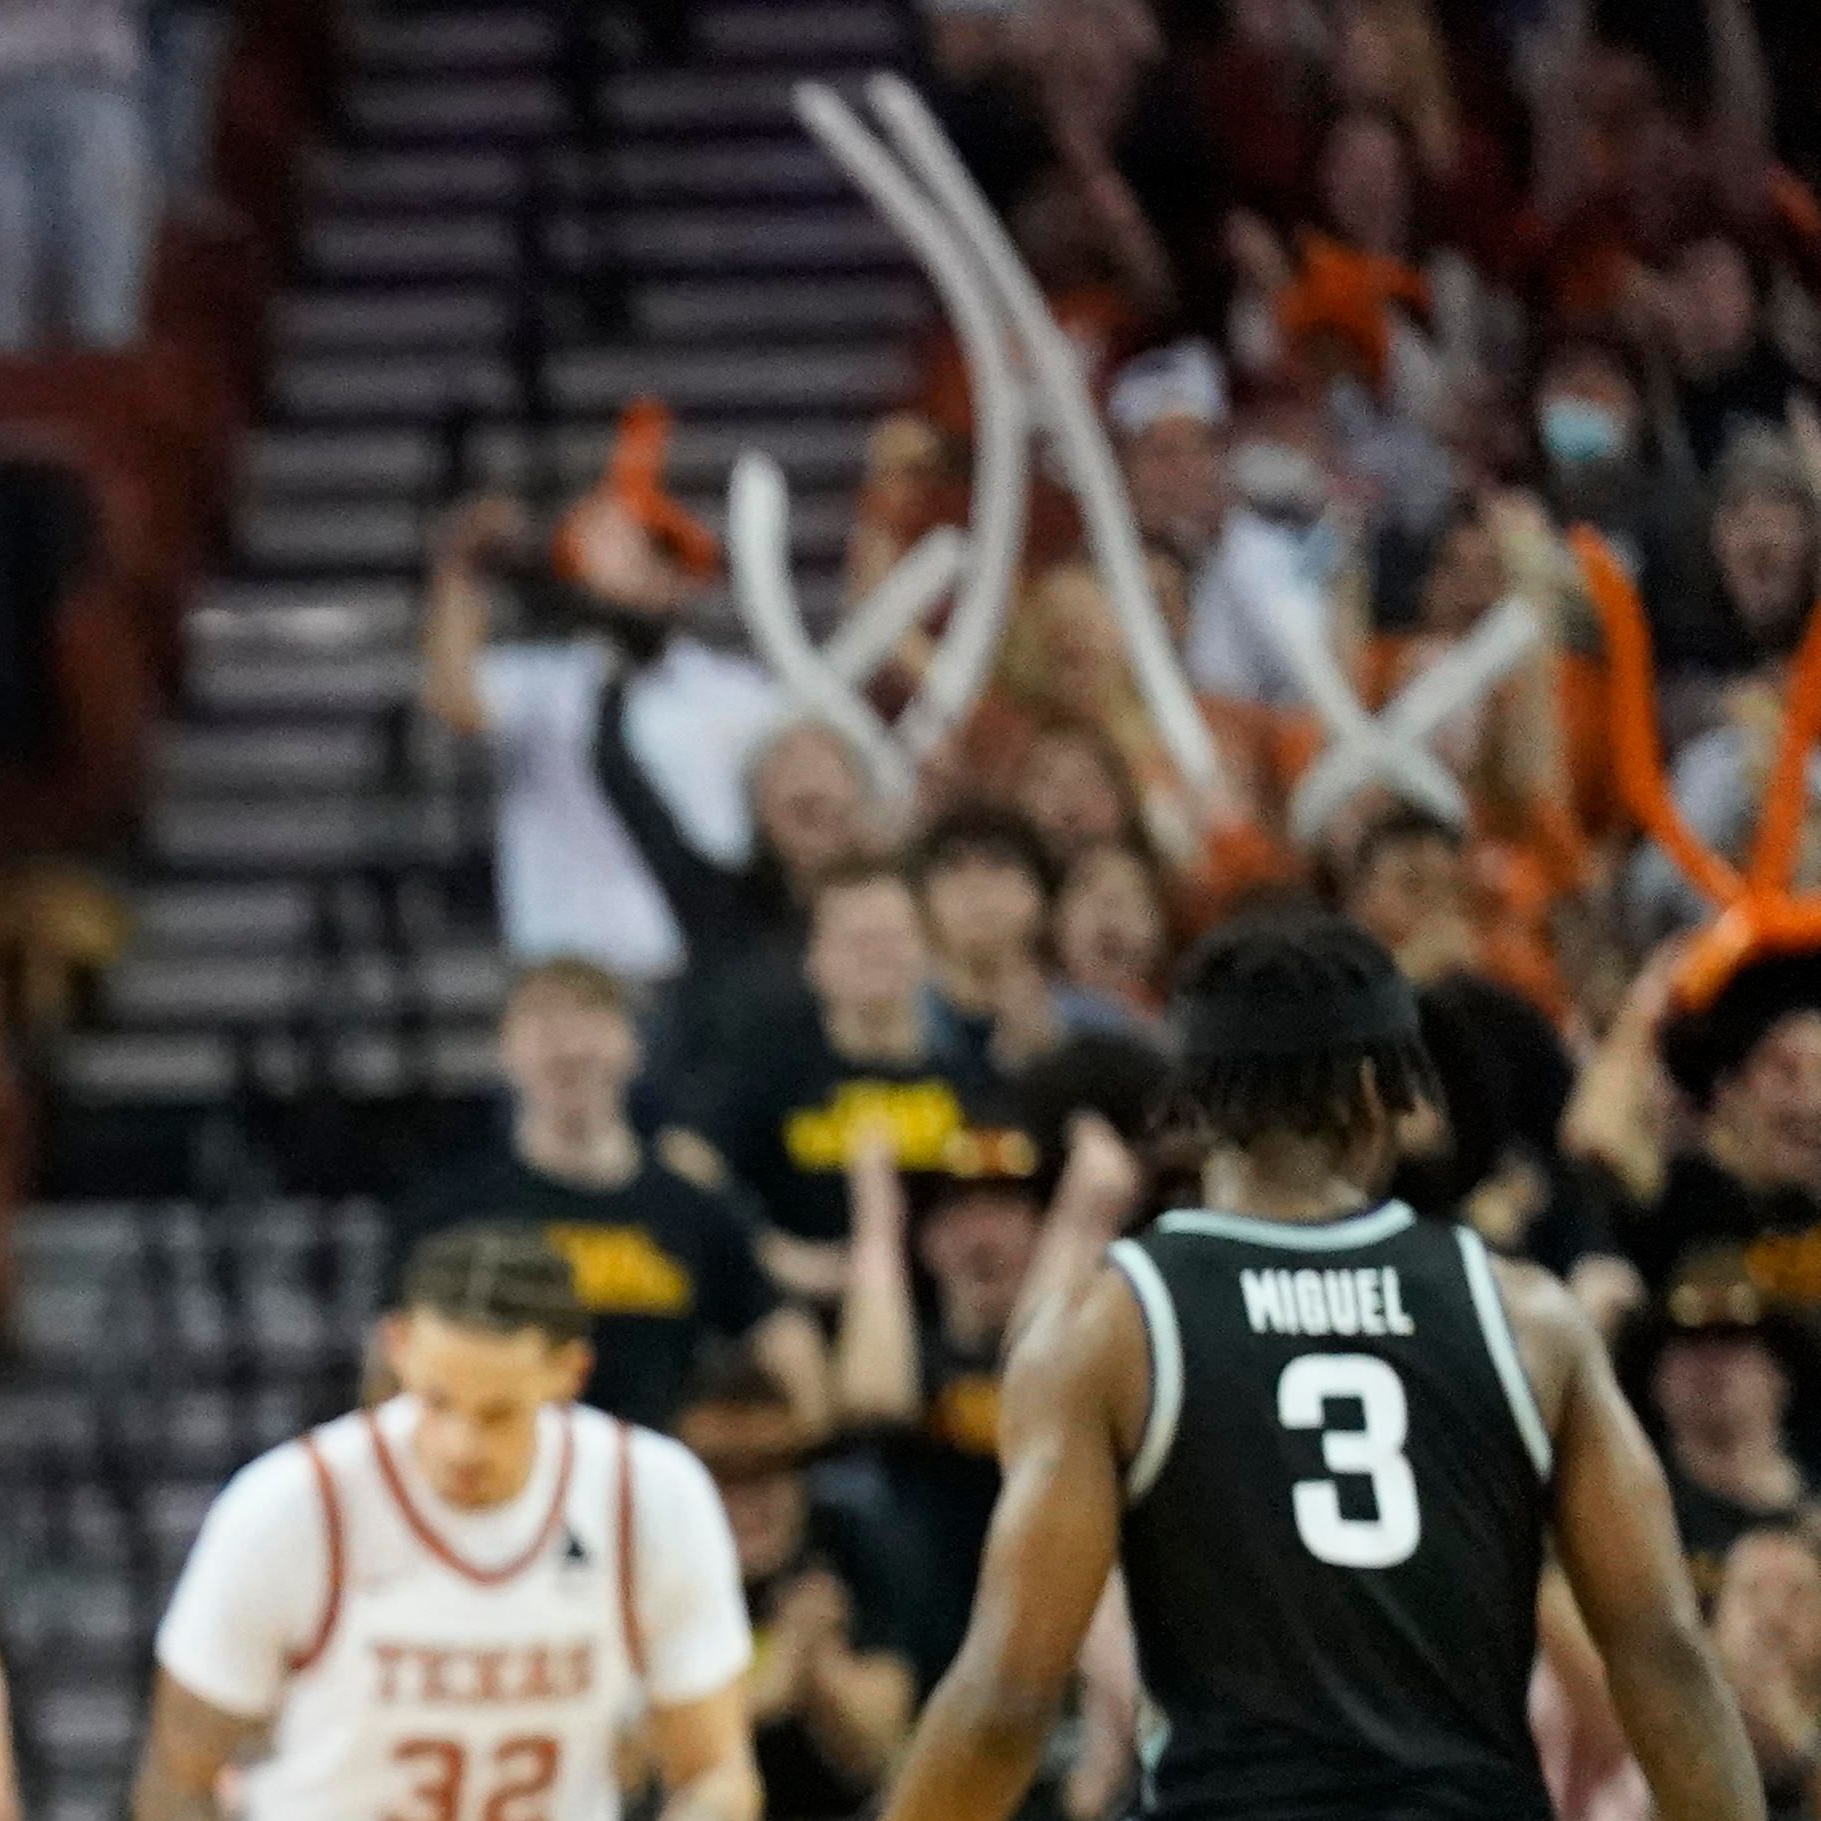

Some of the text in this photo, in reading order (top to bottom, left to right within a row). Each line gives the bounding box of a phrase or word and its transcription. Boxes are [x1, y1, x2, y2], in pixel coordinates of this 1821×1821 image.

[1239, 1265, 1415, 1337] MIGUEL
[1276, 1352, 1422, 1570] 3
[367, 1638, 597, 1703] TEXAS
